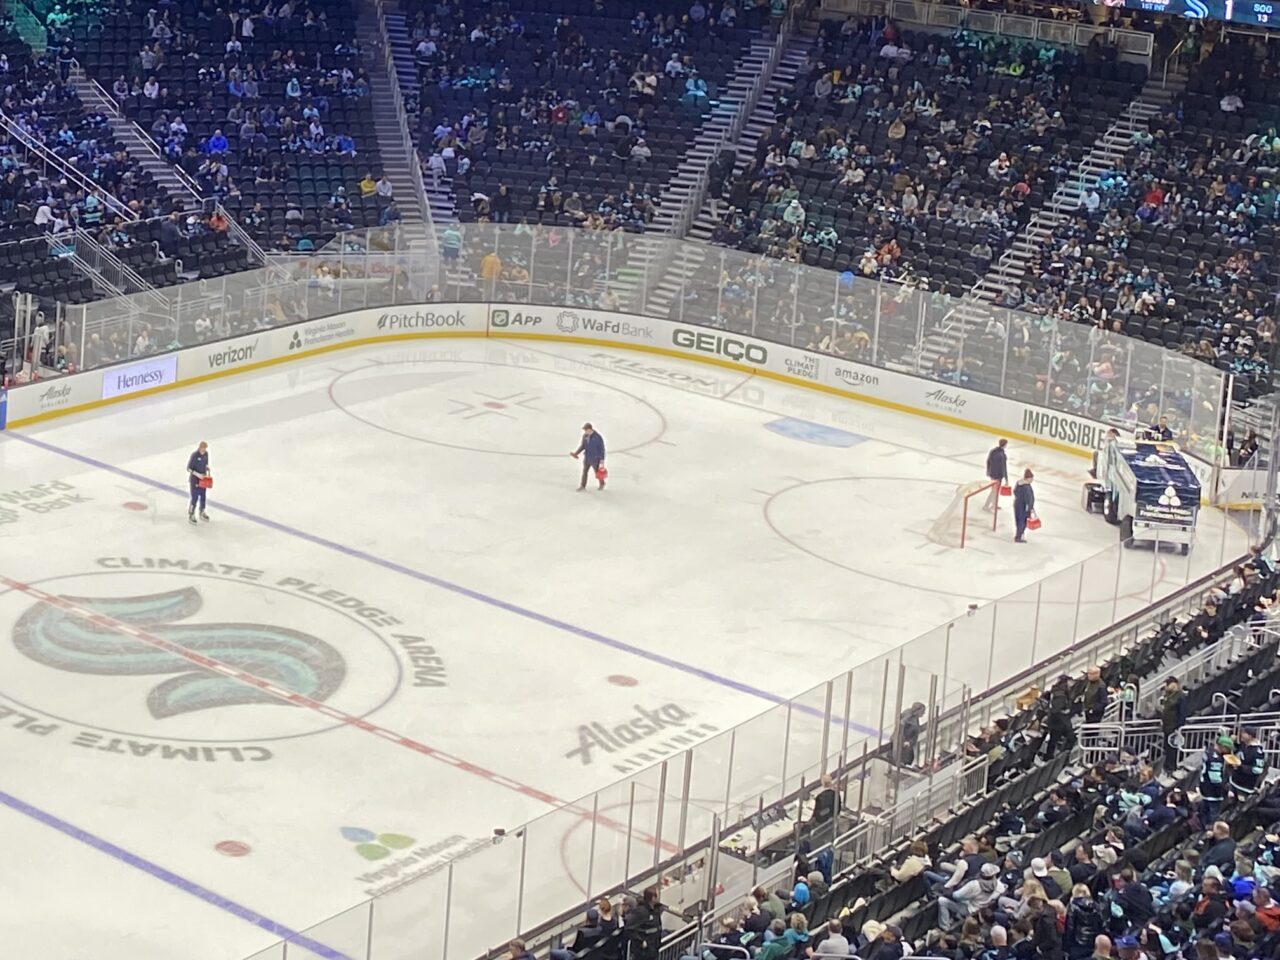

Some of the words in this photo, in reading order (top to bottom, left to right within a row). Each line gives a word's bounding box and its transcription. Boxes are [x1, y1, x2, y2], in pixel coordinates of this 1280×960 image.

[1225, 0, 1233, 20] 1
[1254, 4, 1273, 14] SOG
[389, 310, 465, 330] PitchBook
[581, 319, 620, 334] WaFd
[622, 322, 653, 339] Bank
[208, 346, 254, 368] verizon
[672, 328, 768, 365] GEICO
[117, 369, 165, 391] Hennessy
[835, 366, 879, 386] amazon
[925, 390, 967, 407] Alaska
[1022, 408, 1105, 451] IMPOSSIBLE
[25, 493, 94, 515] Bank
[96, 557, 264, 581] CLIMATE
[276, 576, 403, 629] PLEDGE
[392, 632, 448, 688] ARENA
[565, 699, 691, 766] Alaska
[73, 731, 274, 762] CLIMATE
[612, 722, 719, 775] AIRLINES
